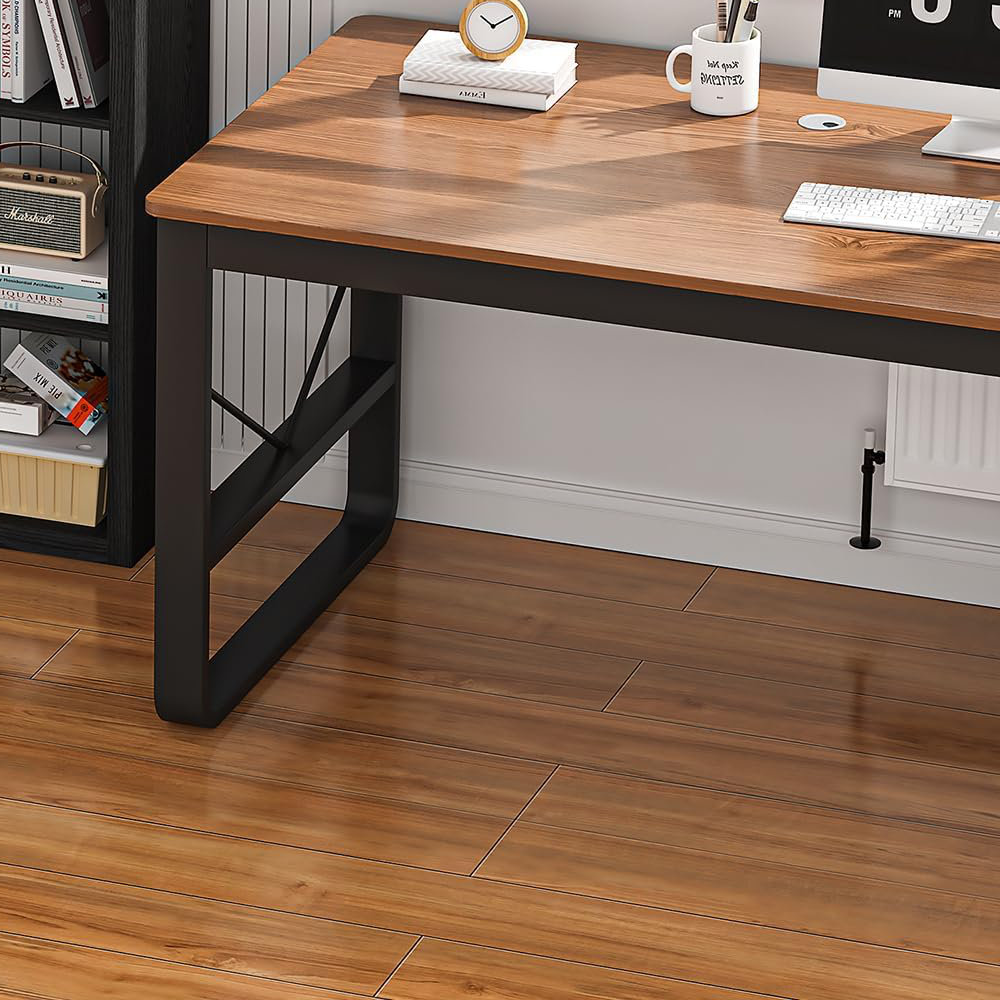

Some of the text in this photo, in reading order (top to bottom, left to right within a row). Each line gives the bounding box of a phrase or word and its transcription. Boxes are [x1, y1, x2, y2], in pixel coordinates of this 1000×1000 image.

[888, 8, 902, 18] PM
[1, 22, 11, 78] SYMBOLS
[4, 206, 56, 225] Marshall
[32, 371, 63, 400] PIE MIX
